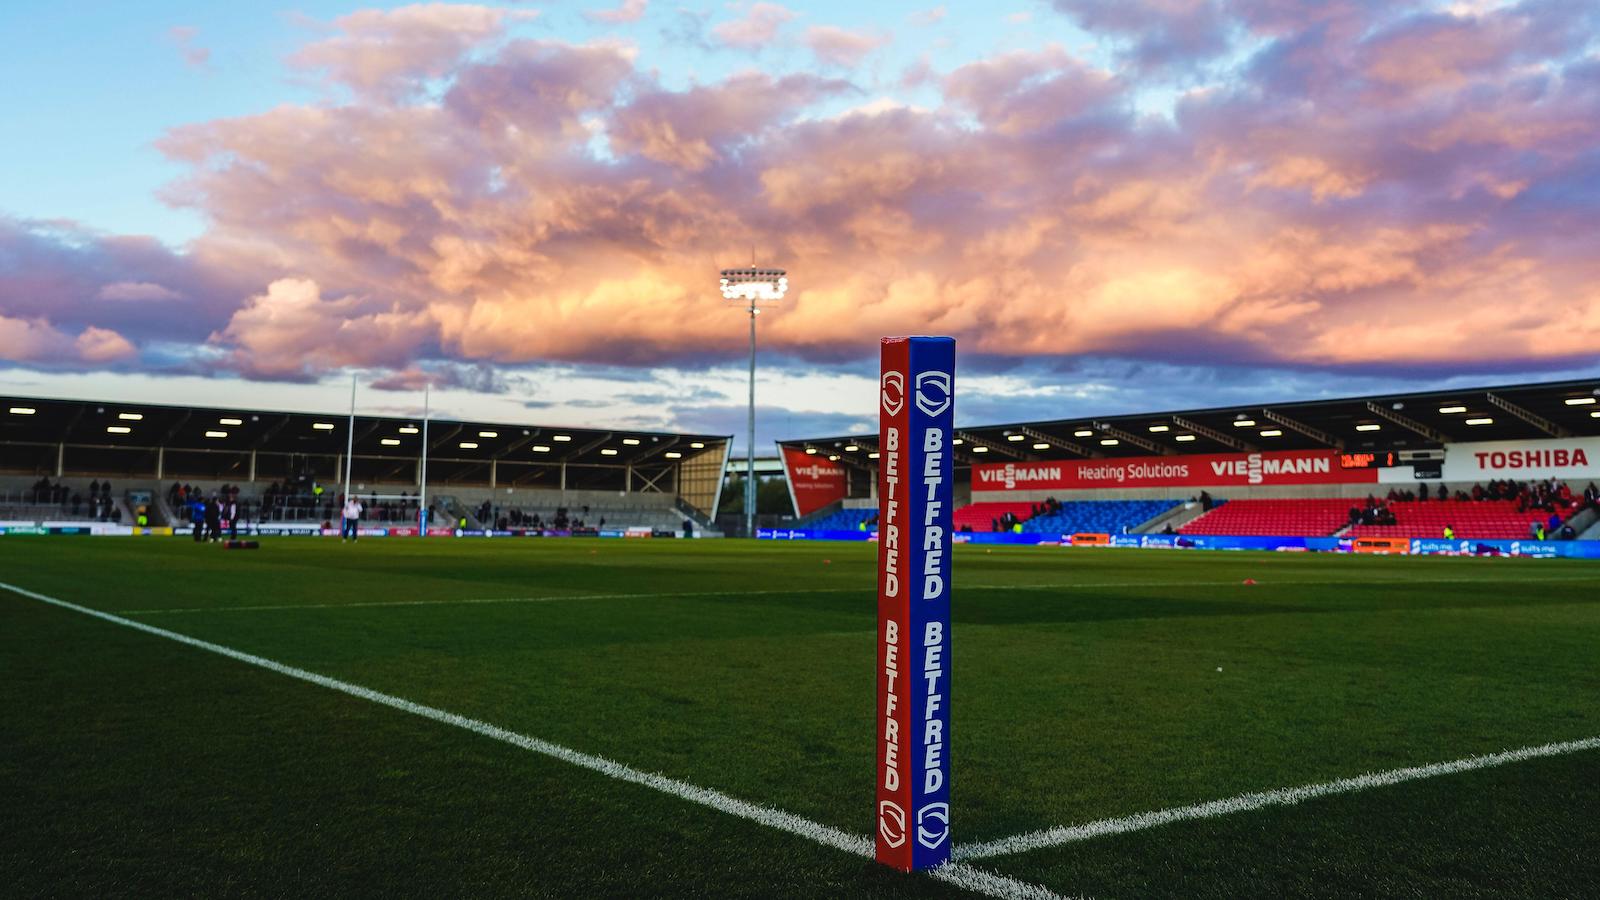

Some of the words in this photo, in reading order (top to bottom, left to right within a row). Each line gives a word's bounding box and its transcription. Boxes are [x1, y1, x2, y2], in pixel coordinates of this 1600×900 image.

[885, 427, 899, 598] BETFRED
[923, 428, 944, 600] BETFRED
[980, 463, 1062, 489] VIESSMANN
[1078, 466, 1124, 482] Heating
[1127, 463, 1189, 480] Solutions
[1210, 453, 1330, 484] VIESSMANN
[1474, 449, 1589, 470] TOSHIBA
[884, 619, 900, 792] BETFRED
[923, 621, 944, 794] BETFRED
